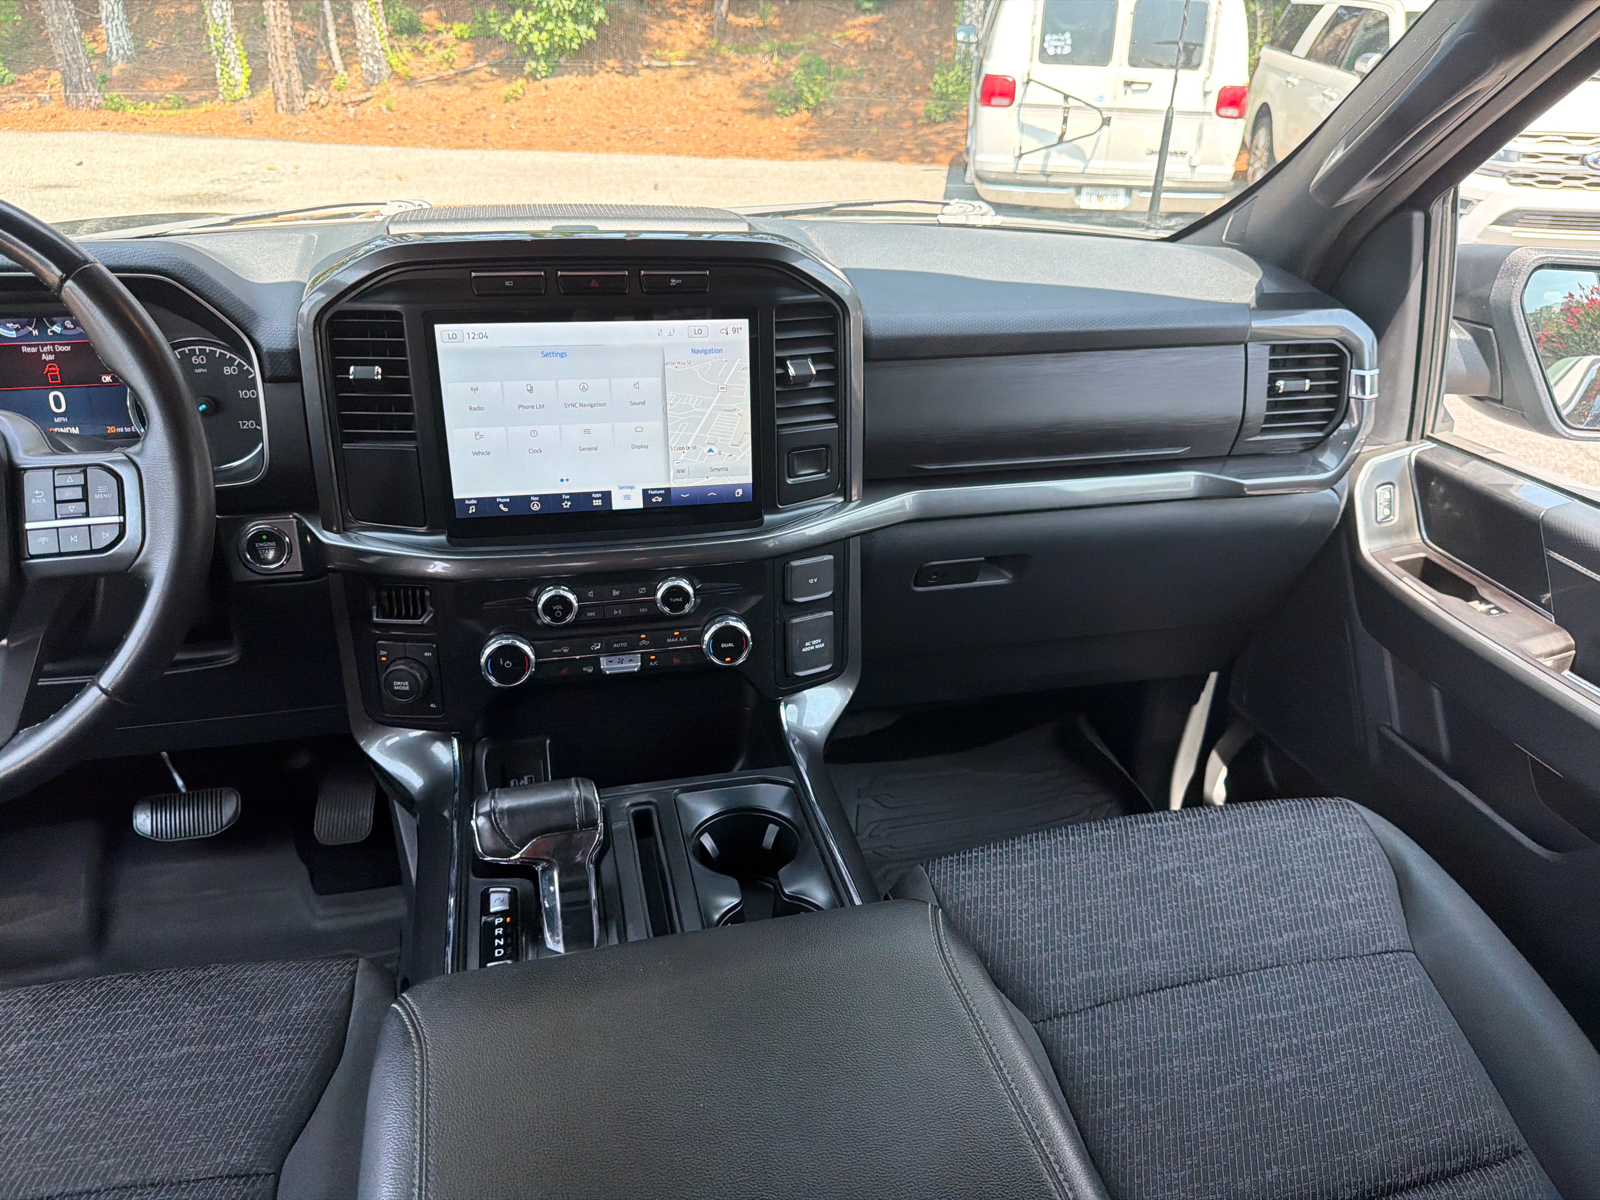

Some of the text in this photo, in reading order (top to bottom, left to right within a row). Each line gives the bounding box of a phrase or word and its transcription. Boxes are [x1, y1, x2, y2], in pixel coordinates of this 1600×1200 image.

[541, 350, 568, 359] Settings
[192, 355, 206, 364] 60
[223, 366, 238, 375] 80
[238, 390, 257, 398] 100
[48, 390, 66, 414] 0
[238, 420, 256, 429] 120
[495, 917, 503, 926] P
[495, 928, 504, 936] R
[495, 938, 504, 946] N
[495, 948, 504, 957] D
